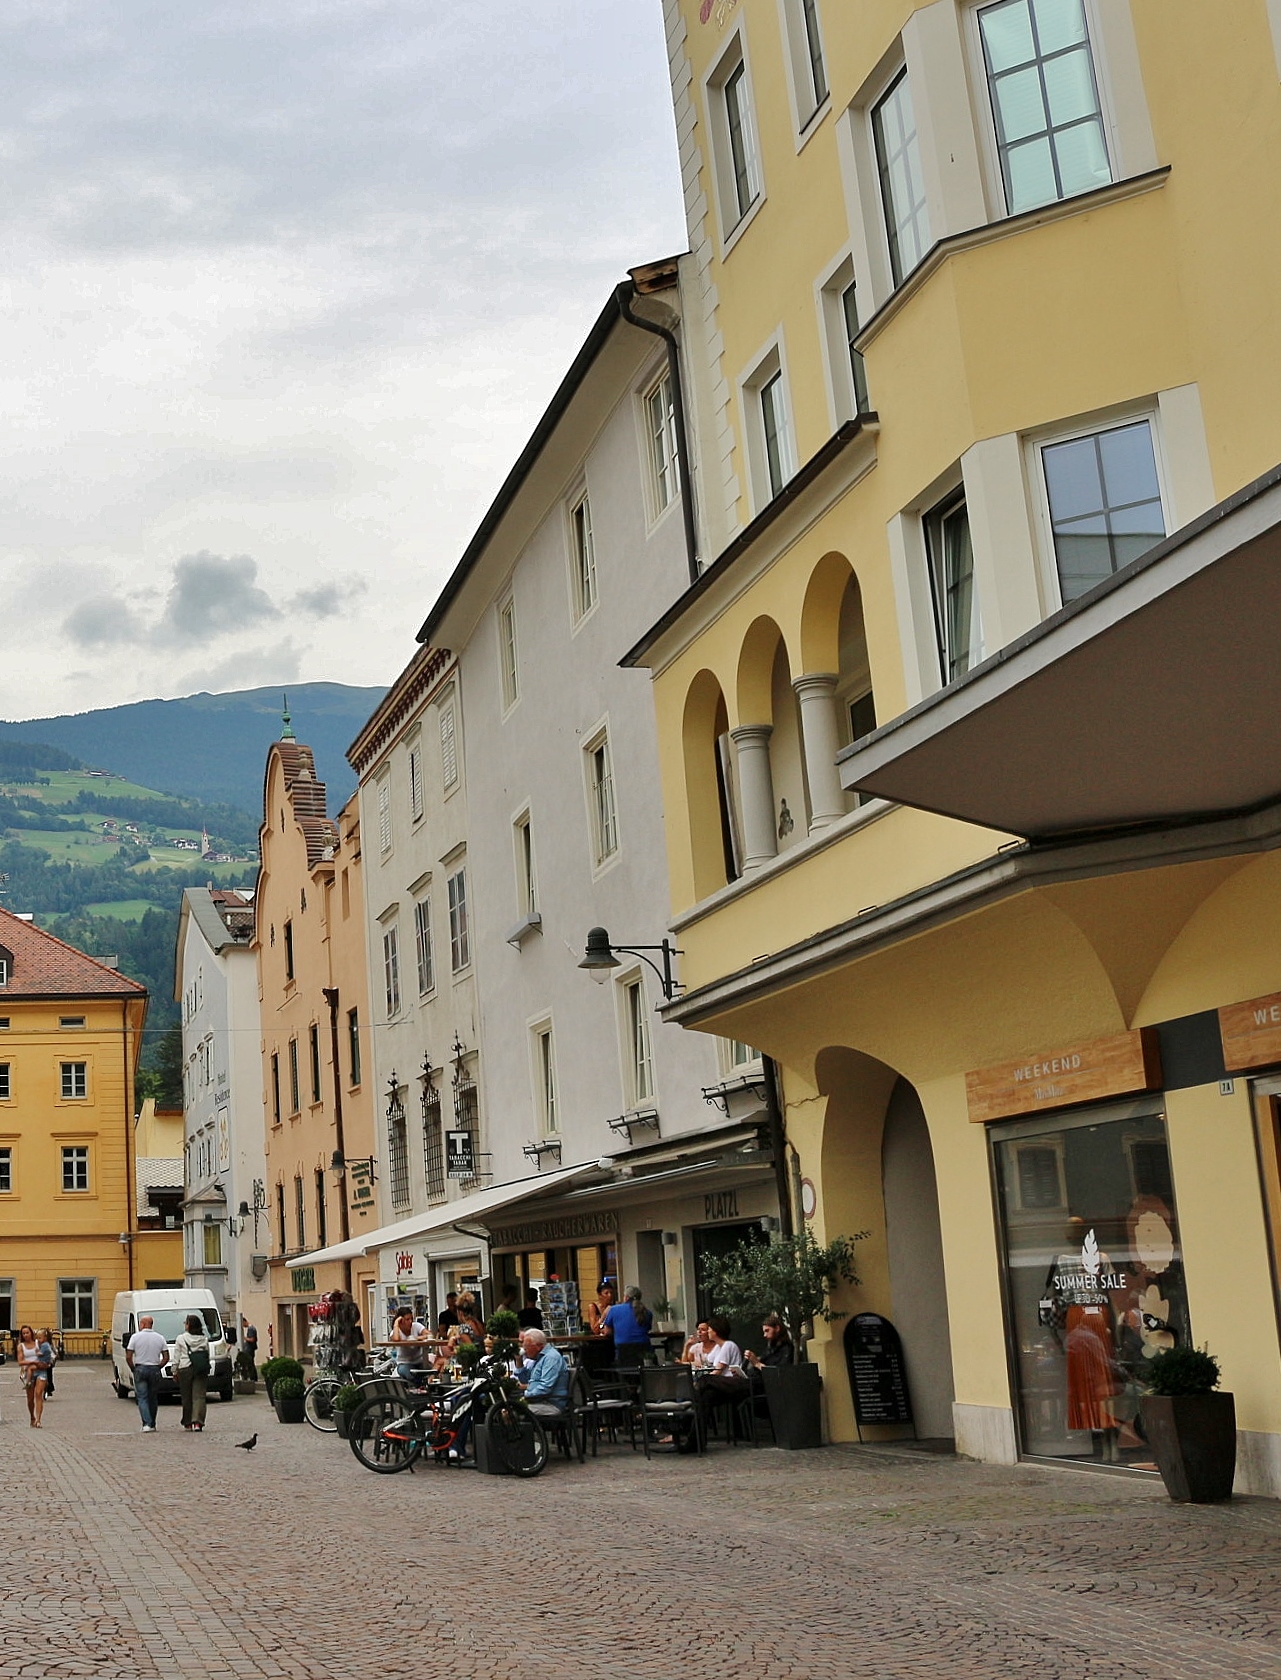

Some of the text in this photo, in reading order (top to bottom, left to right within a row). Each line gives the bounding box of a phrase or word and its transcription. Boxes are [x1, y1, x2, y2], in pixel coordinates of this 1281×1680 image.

[1013, 1054, 1081, 1082] WEEKEND
[449, 1133, 468, 1154] T
[704, 1189, 739, 1220] PLATZL
[1054, 1273, 1127, 1290] SUMMER SALE
